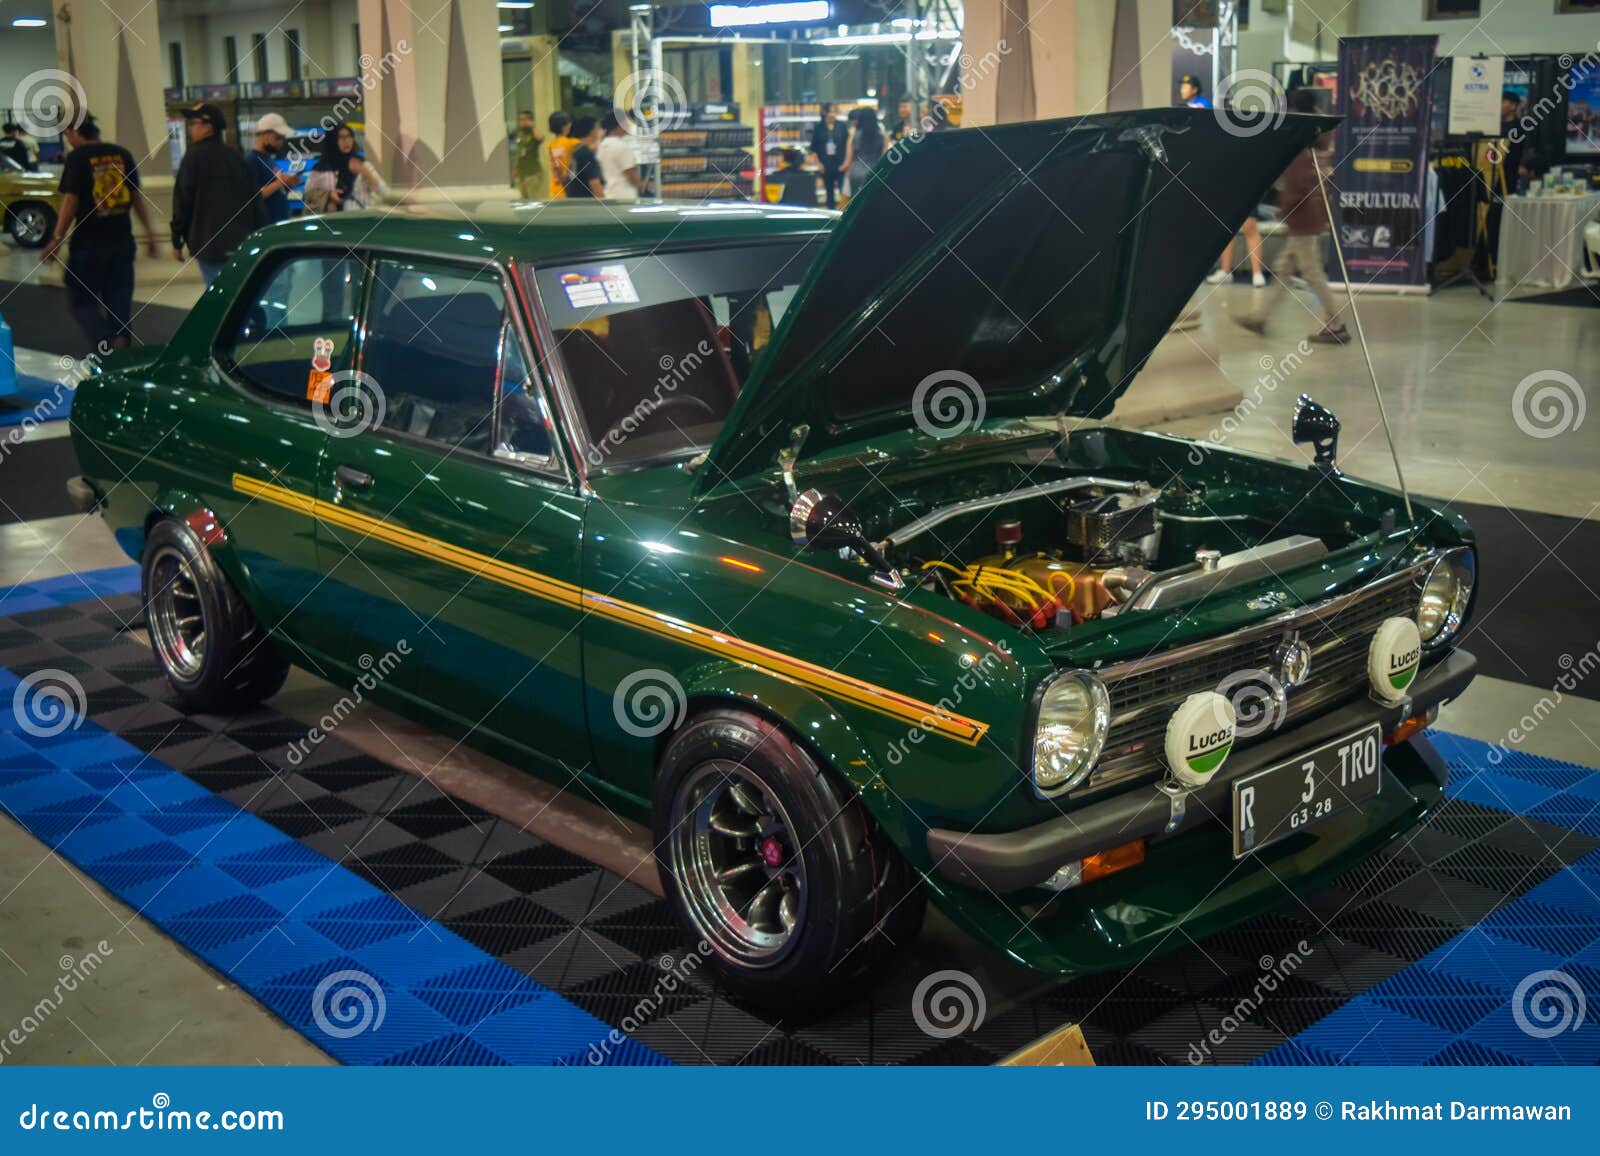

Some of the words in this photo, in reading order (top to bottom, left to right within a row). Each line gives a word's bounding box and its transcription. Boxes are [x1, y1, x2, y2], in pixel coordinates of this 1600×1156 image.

[1339, 191, 1420, 209] SEPULTURA
[1391, 646, 1419, 669] Lucas
[1189, 725, 1232, 751] Lucas
[1240, 786, 1255, 831] R
[1301, 760, 1315, 803] 3
[1338, 735, 1376, 786] TRO
